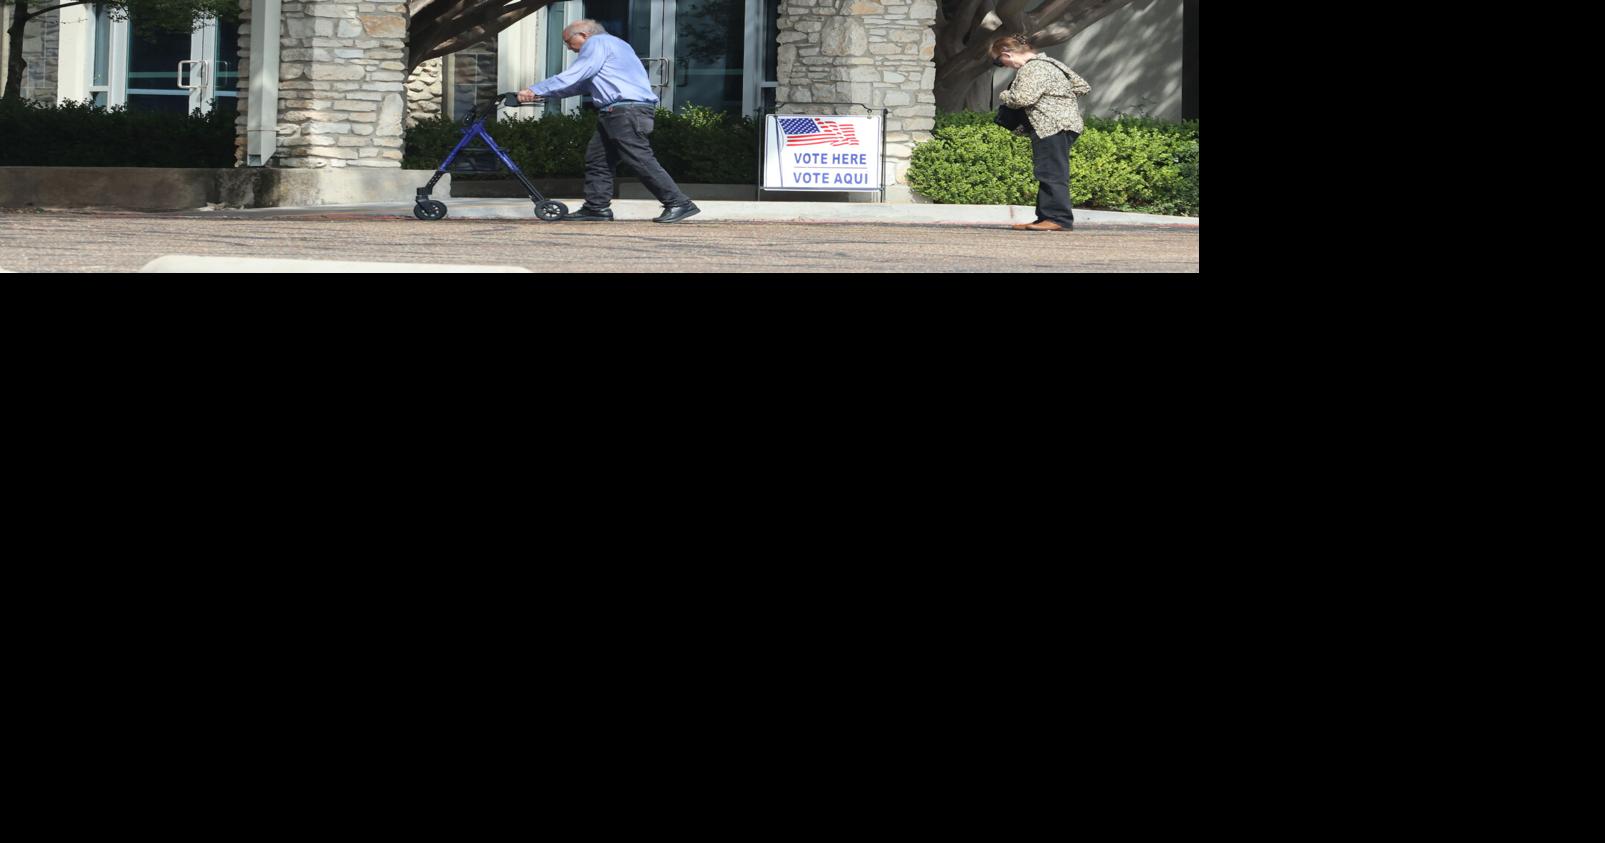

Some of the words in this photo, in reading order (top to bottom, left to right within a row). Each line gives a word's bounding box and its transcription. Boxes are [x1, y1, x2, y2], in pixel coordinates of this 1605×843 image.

[794, 153, 828, 164] VOTE
[832, 153, 867, 165] HERE
[793, 172, 829, 184] VOTE
[834, 173, 868, 185] AQUI
